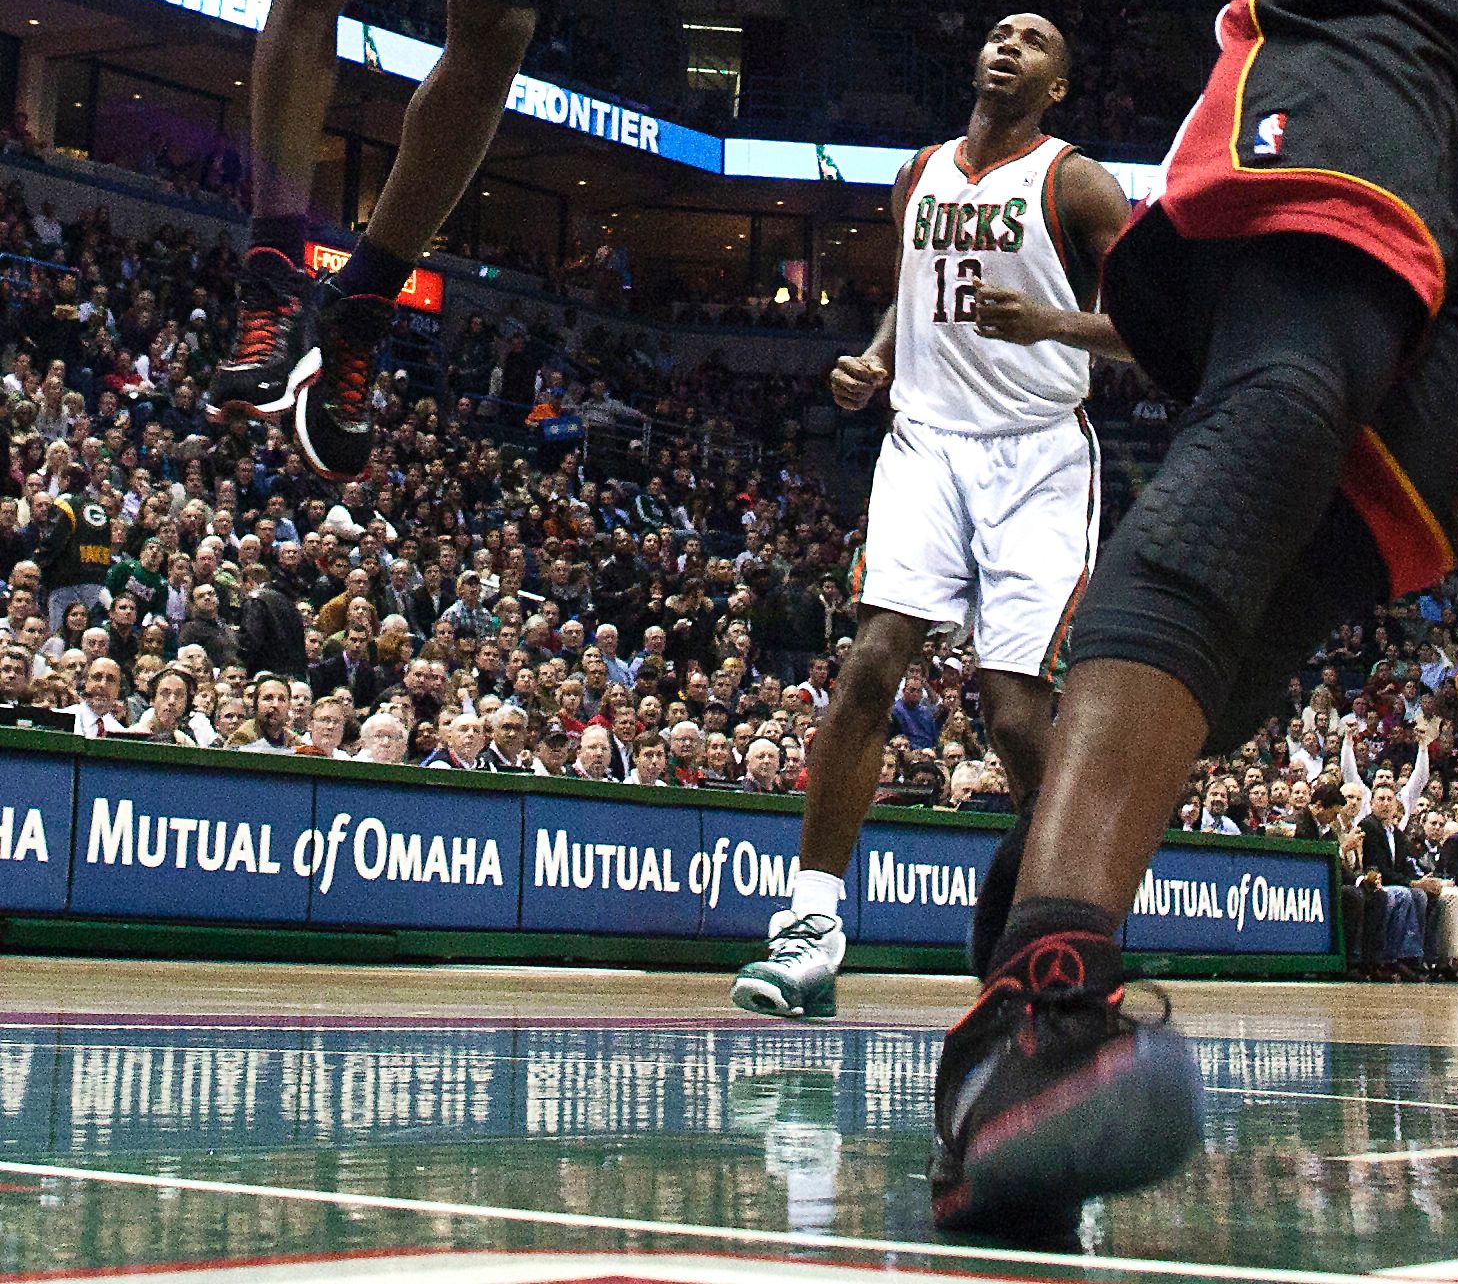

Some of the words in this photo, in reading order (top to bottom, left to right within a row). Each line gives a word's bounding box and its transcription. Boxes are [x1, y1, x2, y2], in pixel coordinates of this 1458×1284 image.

[505, 73, 660, 154] FRONTIER
[913, 194, 1027, 253] BUCKS
[932, 257, 983, 324] 12
[83, 504, 108, 527] G
[86, 797, 281, 874] MUTUAL
[293, 812, 352, 895] of
[353, 817, 503, 886] OMAHA
[534, 828, 680, 893] MUTUAL
[688, 837, 730, 909] of
[867, 850, 978, 906] MUTUAL
[1133, 868, 1223, 919] MUTUAL
[1226, 873, 1252, 932] of
[1252, 875, 1324, 923] OMAHA
